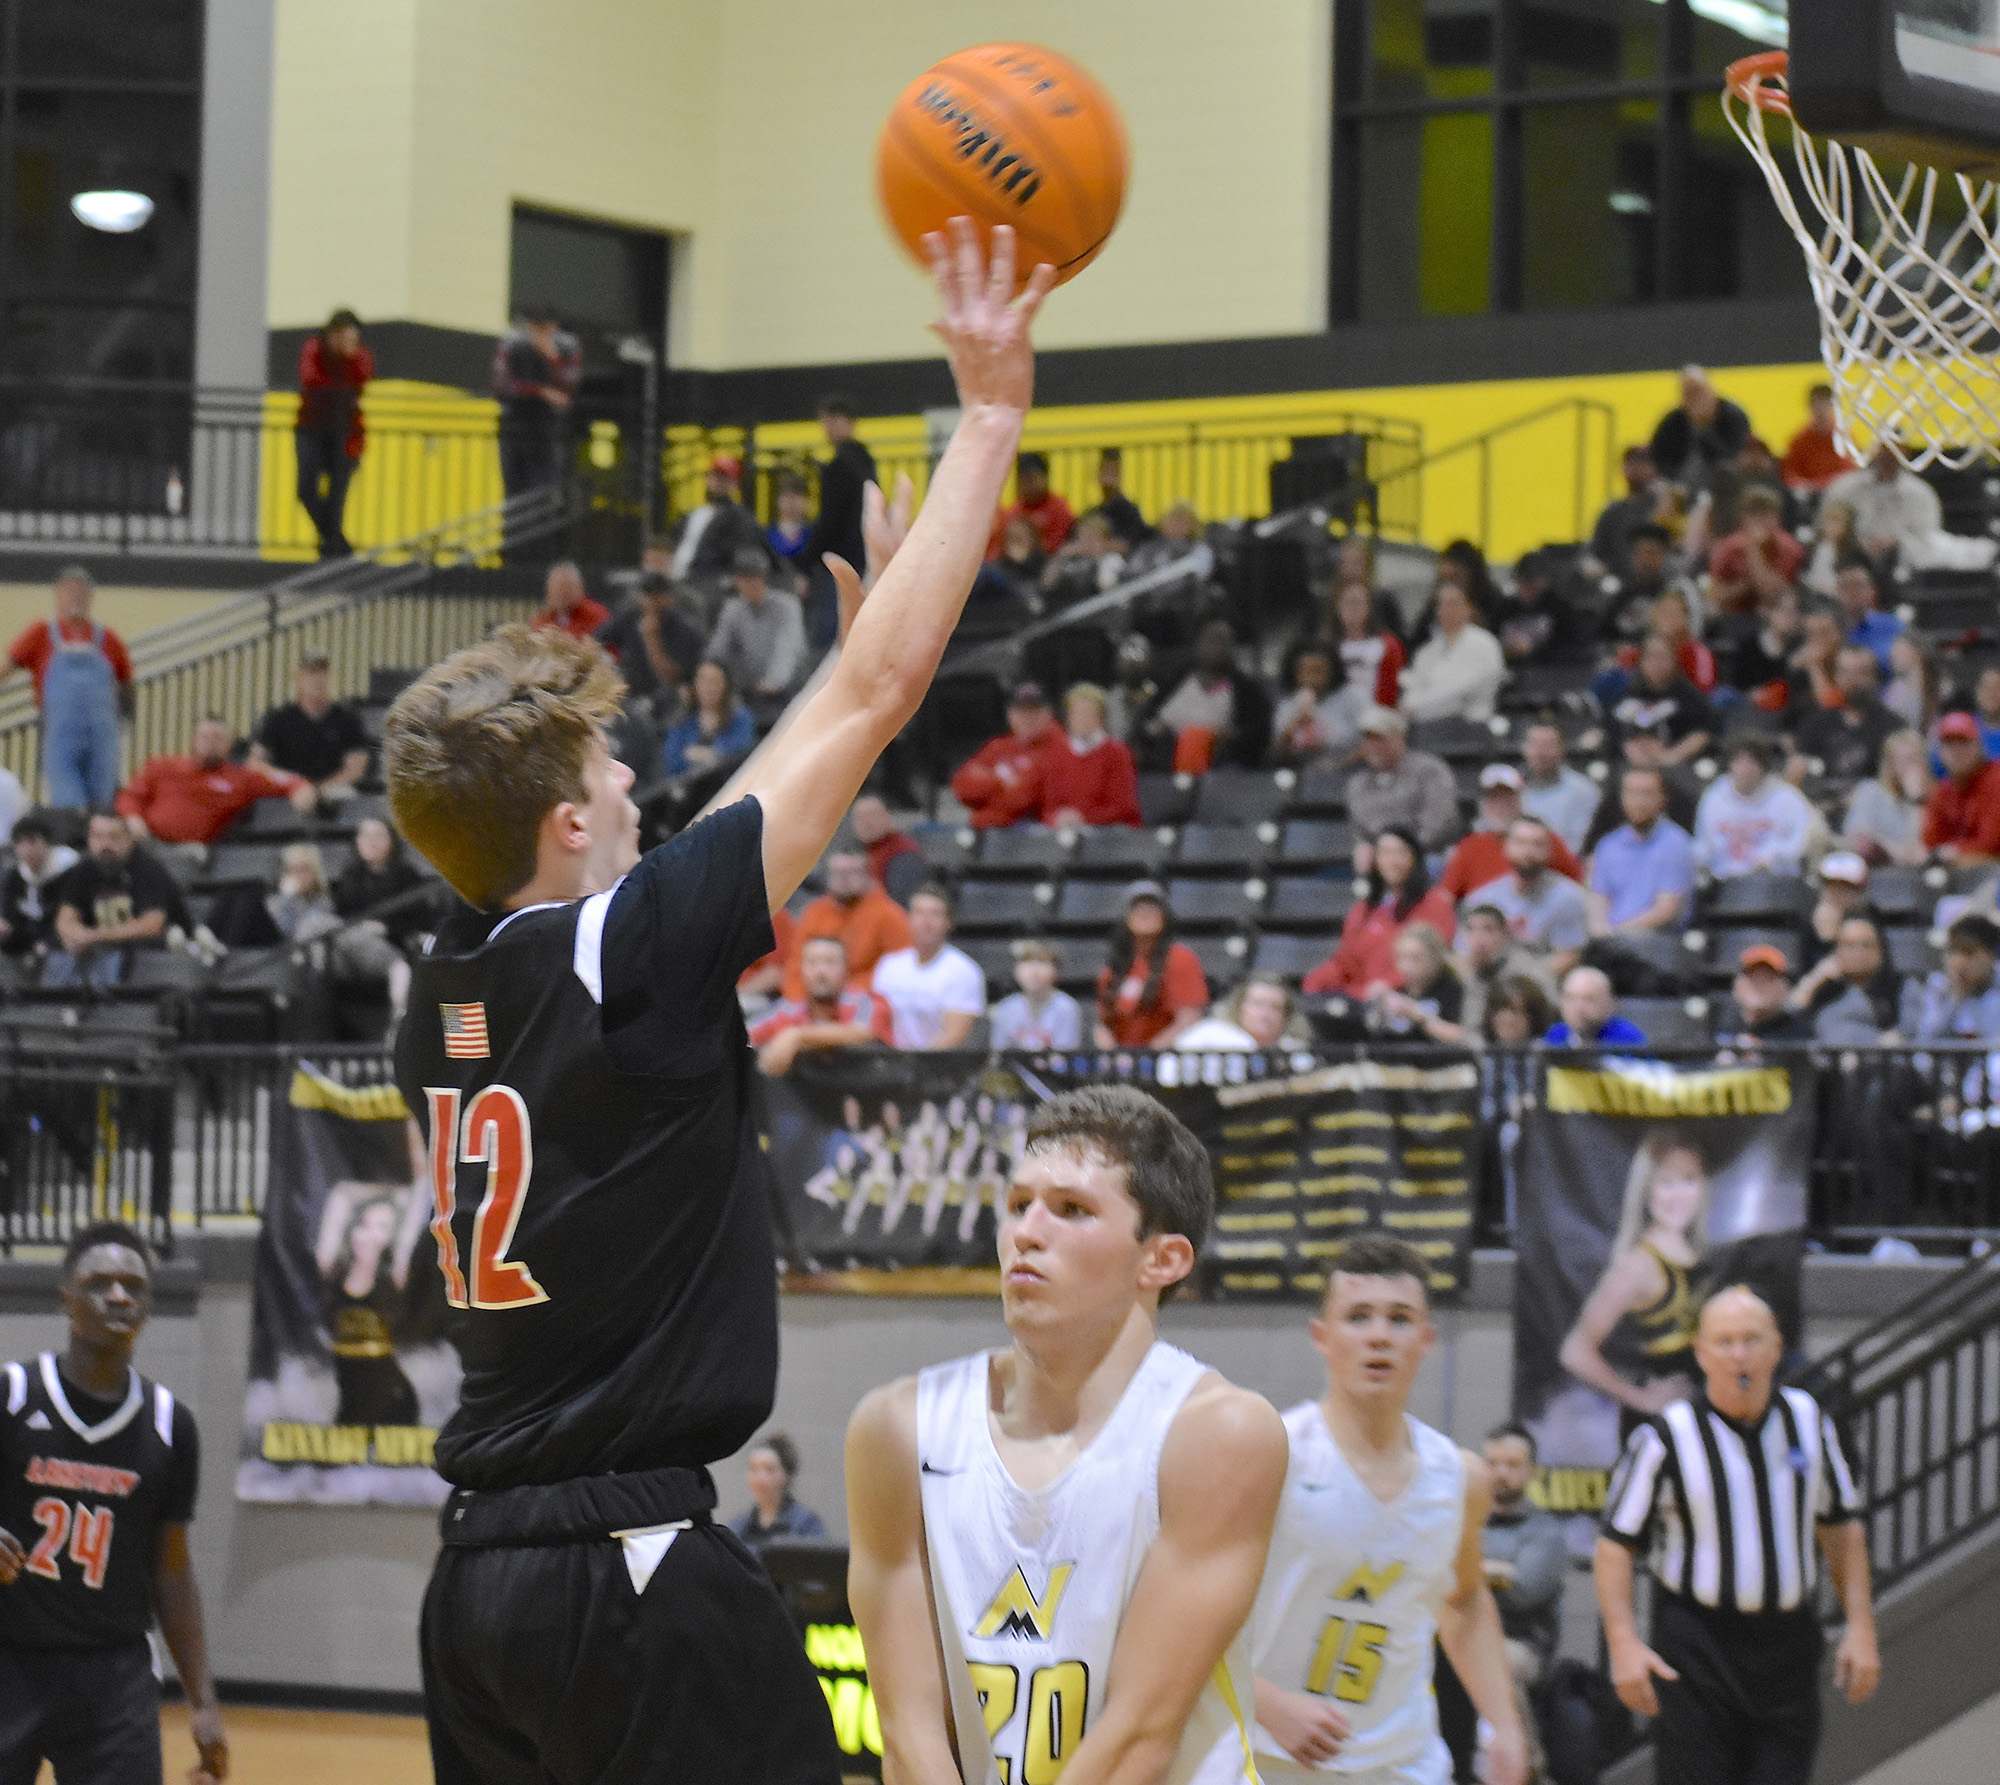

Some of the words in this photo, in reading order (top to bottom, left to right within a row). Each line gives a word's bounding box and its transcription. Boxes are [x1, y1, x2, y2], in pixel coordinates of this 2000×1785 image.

[422, 1083, 551, 1310] 12
[25, 1497, 115, 1590] 24
[1305, 1614, 1390, 1704] 15
